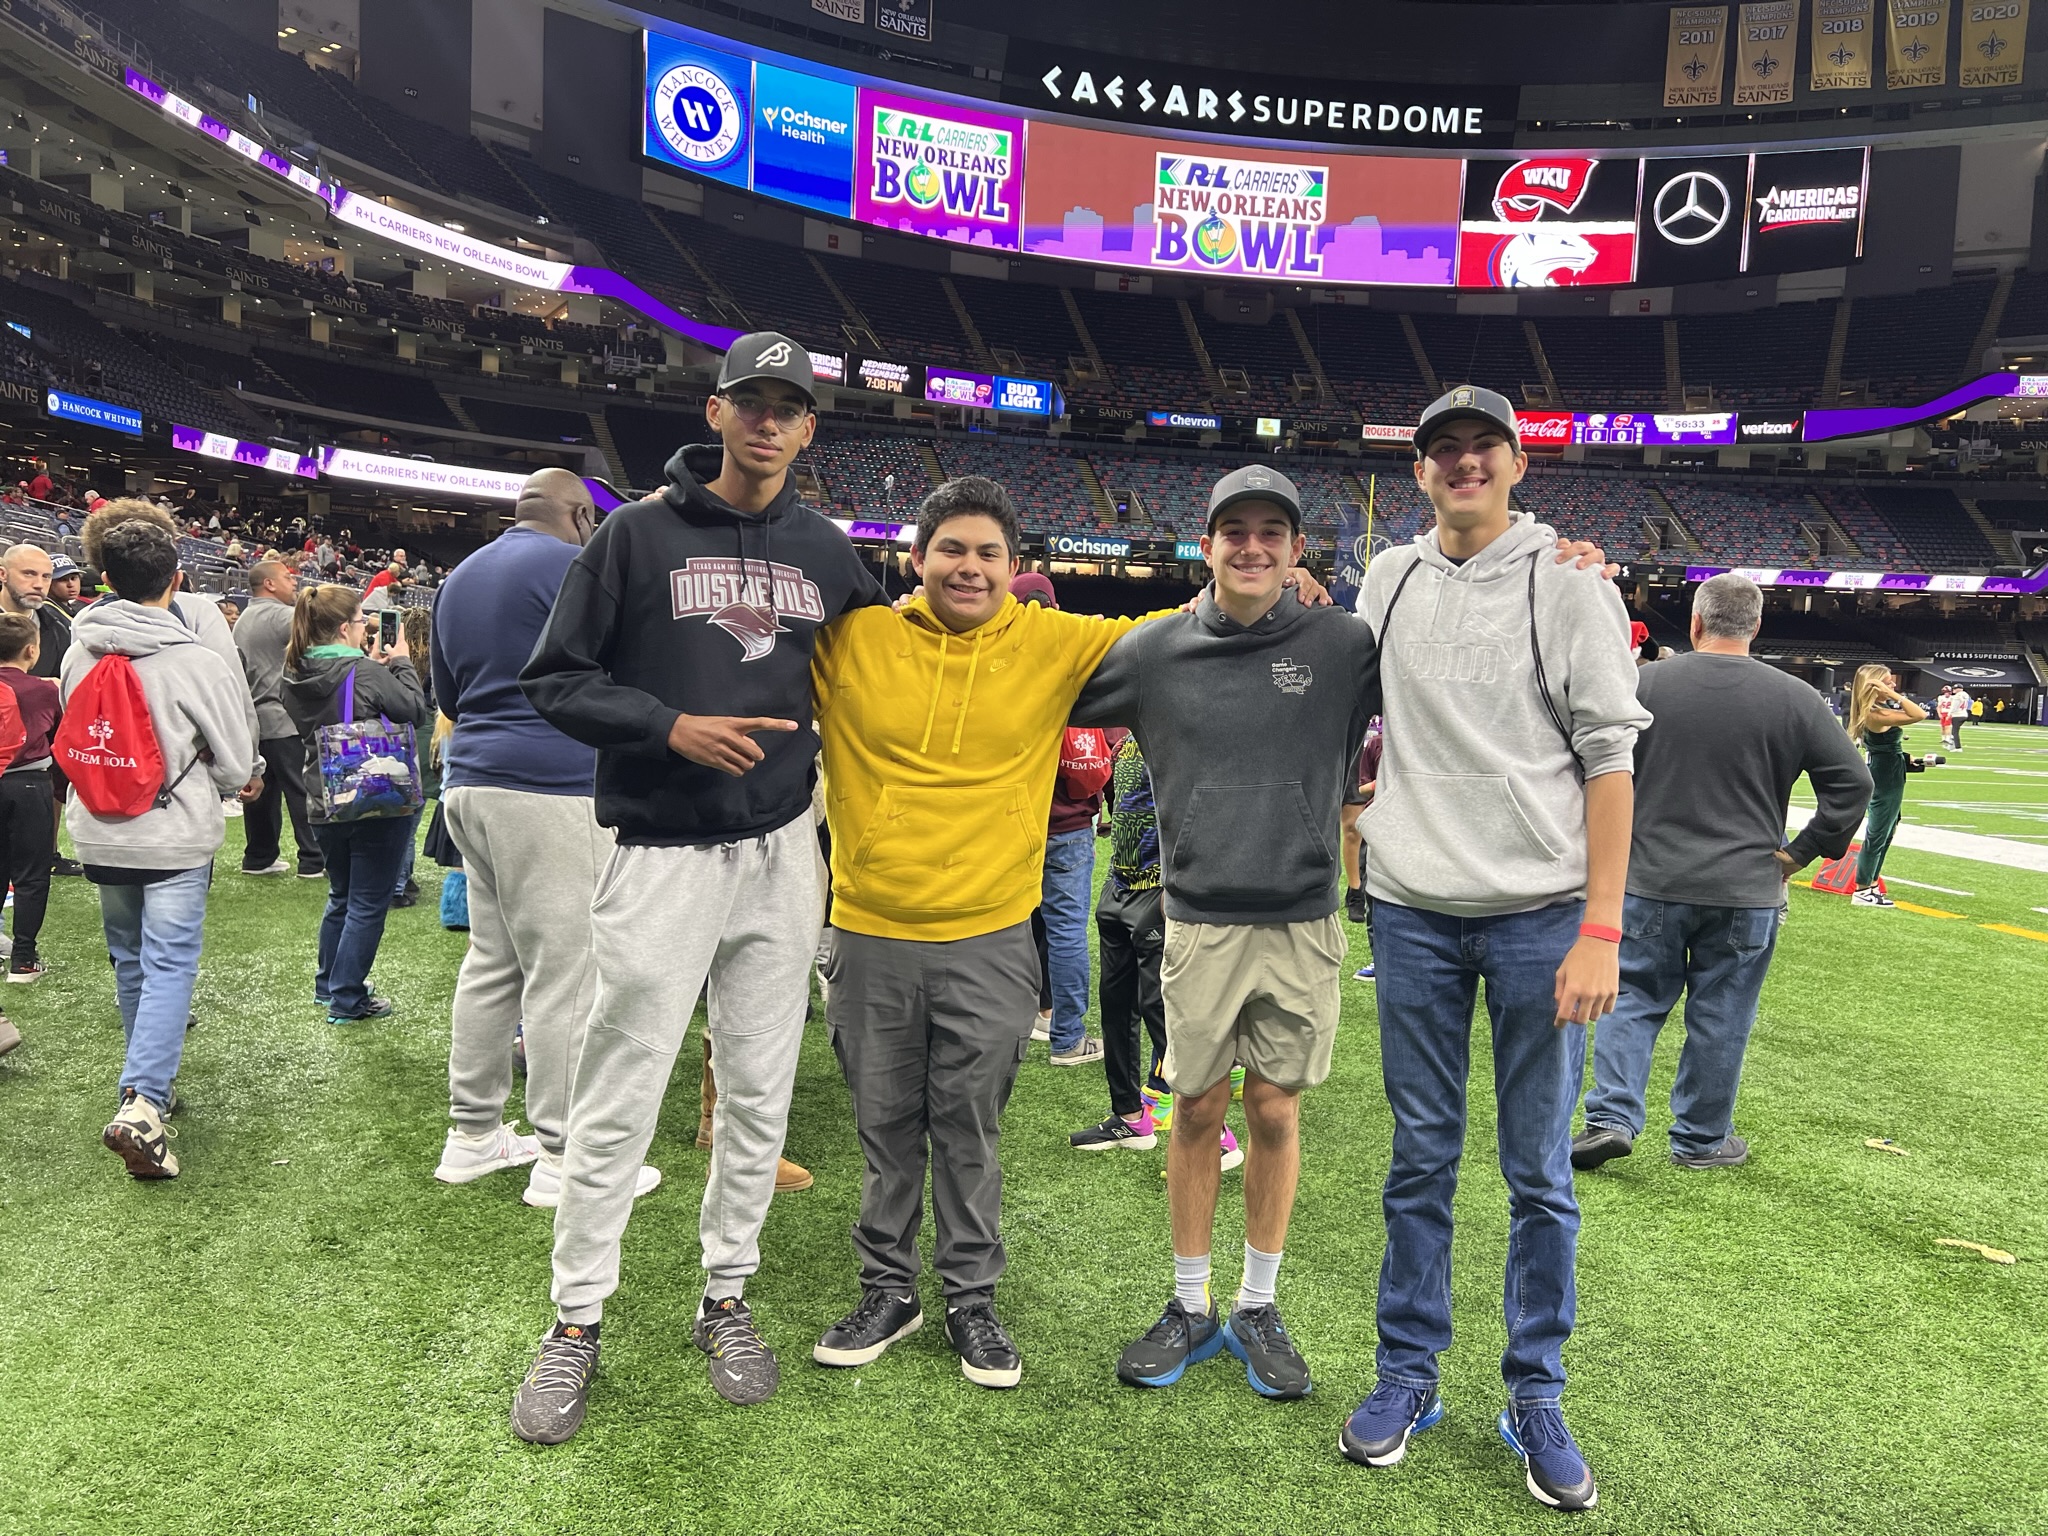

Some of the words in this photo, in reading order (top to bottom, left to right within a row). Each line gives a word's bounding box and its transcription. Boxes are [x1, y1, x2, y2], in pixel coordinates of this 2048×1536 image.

[881, 7, 897, 17] NEW
[898, 12, 927, 24] ORLEANS
[1744, 11, 1794, 22] CHAMPIONS
[1818, 4, 1869, 16] CHAMPIONS
[1971, 4, 2020, 22] 2020
[880, 15, 927, 37] SAINTS
[1675, 17, 1723, 26] CHAMPIONS
[1822, 18, 1863, 34] 2018
[1896, 12, 1939, 28] 2019
[1679, 30, 1715, 45] 2011
[1748, 25, 1788, 42] 2017
[73, 39, 119, 77] SAINTS
[1815, 76, 1867, 89] SAINTS
[1888, 73, 1941, 88] SAINTS
[1963, 71, 2018, 86] SAINTS
[404, 88, 418, 97] 647
[660, 69, 735, 113] HANCOCK
[1668, 92, 1717, 105] SAINTS
[1738, 89, 1789, 103] SAINTS
[1041, 65, 1247, 123] CAESARS
[1252, 95, 1484, 134] SUPERDOME
[781, 107, 848, 135] Ochsner
[661, 114, 734, 159] WHITNEY
[781, 124, 825, 145] Health
[937, 127, 989, 152] CARRIERS
[876, 136, 919, 160] NEW
[924, 146, 1007, 176] ORLEANS
[1234, 168, 1299, 194] CARRIERS
[1522, 166, 1572, 191] WKU
[875, 157, 1006, 218] BOWL
[1158, 187, 1211, 212] NEW
[1217, 193, 1322, 221] ORLEANS
[1756, 185, 1859, 209] AMERICAS
[39, 200, 81, 226] SAINTS
[1766, 206, 1858, 224] CARDROOM.NET
[132, 235, 173, 259] SAINTS
[355, 205, 377, 225] R+L
[378, 215, 433, 244] CARRIERS
[435, 237, 461, 254] NEW
[463, 246, 514, 272] ORLEANS
[515, 263, 550, 281] BOWL
[1155, 212, 1320, 272] BOWL
[225, 266, 270, 289] SAINTS
[323, 294, 368, 314] SAINTS
[422, 316, 466, 334] SAINTS
[520, 335, 564, 351] SAINTS
[808, 352, 843, 369] MERICAS
[862, 359, 908, 373] WEDNESDAY
[859, 366, 900, 380] DECEMBER
[0, 380, 39, 404] AINTS
[865, 376, 887, 391] 7:08
[888, 381, 902, 393] PM
[1006, 382, 1038, 397] BUD
[2021, 386, 2048, 394] BOW
[1001, 394, 1042, 410] LIGHT
[62, 401, 102, 419] HANCOCK
[103, 411, 143, 429] WHITNEY
[1098, 408, 1134, 419] SAINTS
[1170, 414, 1216, 428] Chevron
[1292, 421, 1328, 432] SAINTS
[1365, 426, 1396, 437] ROUSES
[1675, 420, 1705, 428] 56:33
[1741, 421, 1792, 435] verizon
[1592, 431, 1601, 441] 0
[1617, 431, 1627, 441] 0
[2020, 441, 2048, 450] SAIN
[342, 459, 363, 472] R+L
[365, 463, 419, 480] CARRIERS
[421, 472, 447, 483] NEW
[449, 475, 502, 490] ORLEANS
[1058, 537, 1129, 556] Ochsner
[1178, 545, 1203, 556] PEOP
[1301, 550, 1322, 559] NTS
[52, 556, 76, 569] FIRST
[713, 562, 726, 570] A&M
[993, 658, 1008, 667] NIKE
[1403, 641, 1500, 684] PUMA
[1273, 673, 1313, 688] TEXAS
[68, 748, 100, 765] STEM
[1061, 759, 1087, 770] STEM
[1089, 757, 1111, 770] NOA
[1816, 850, 1858, 889] 20
